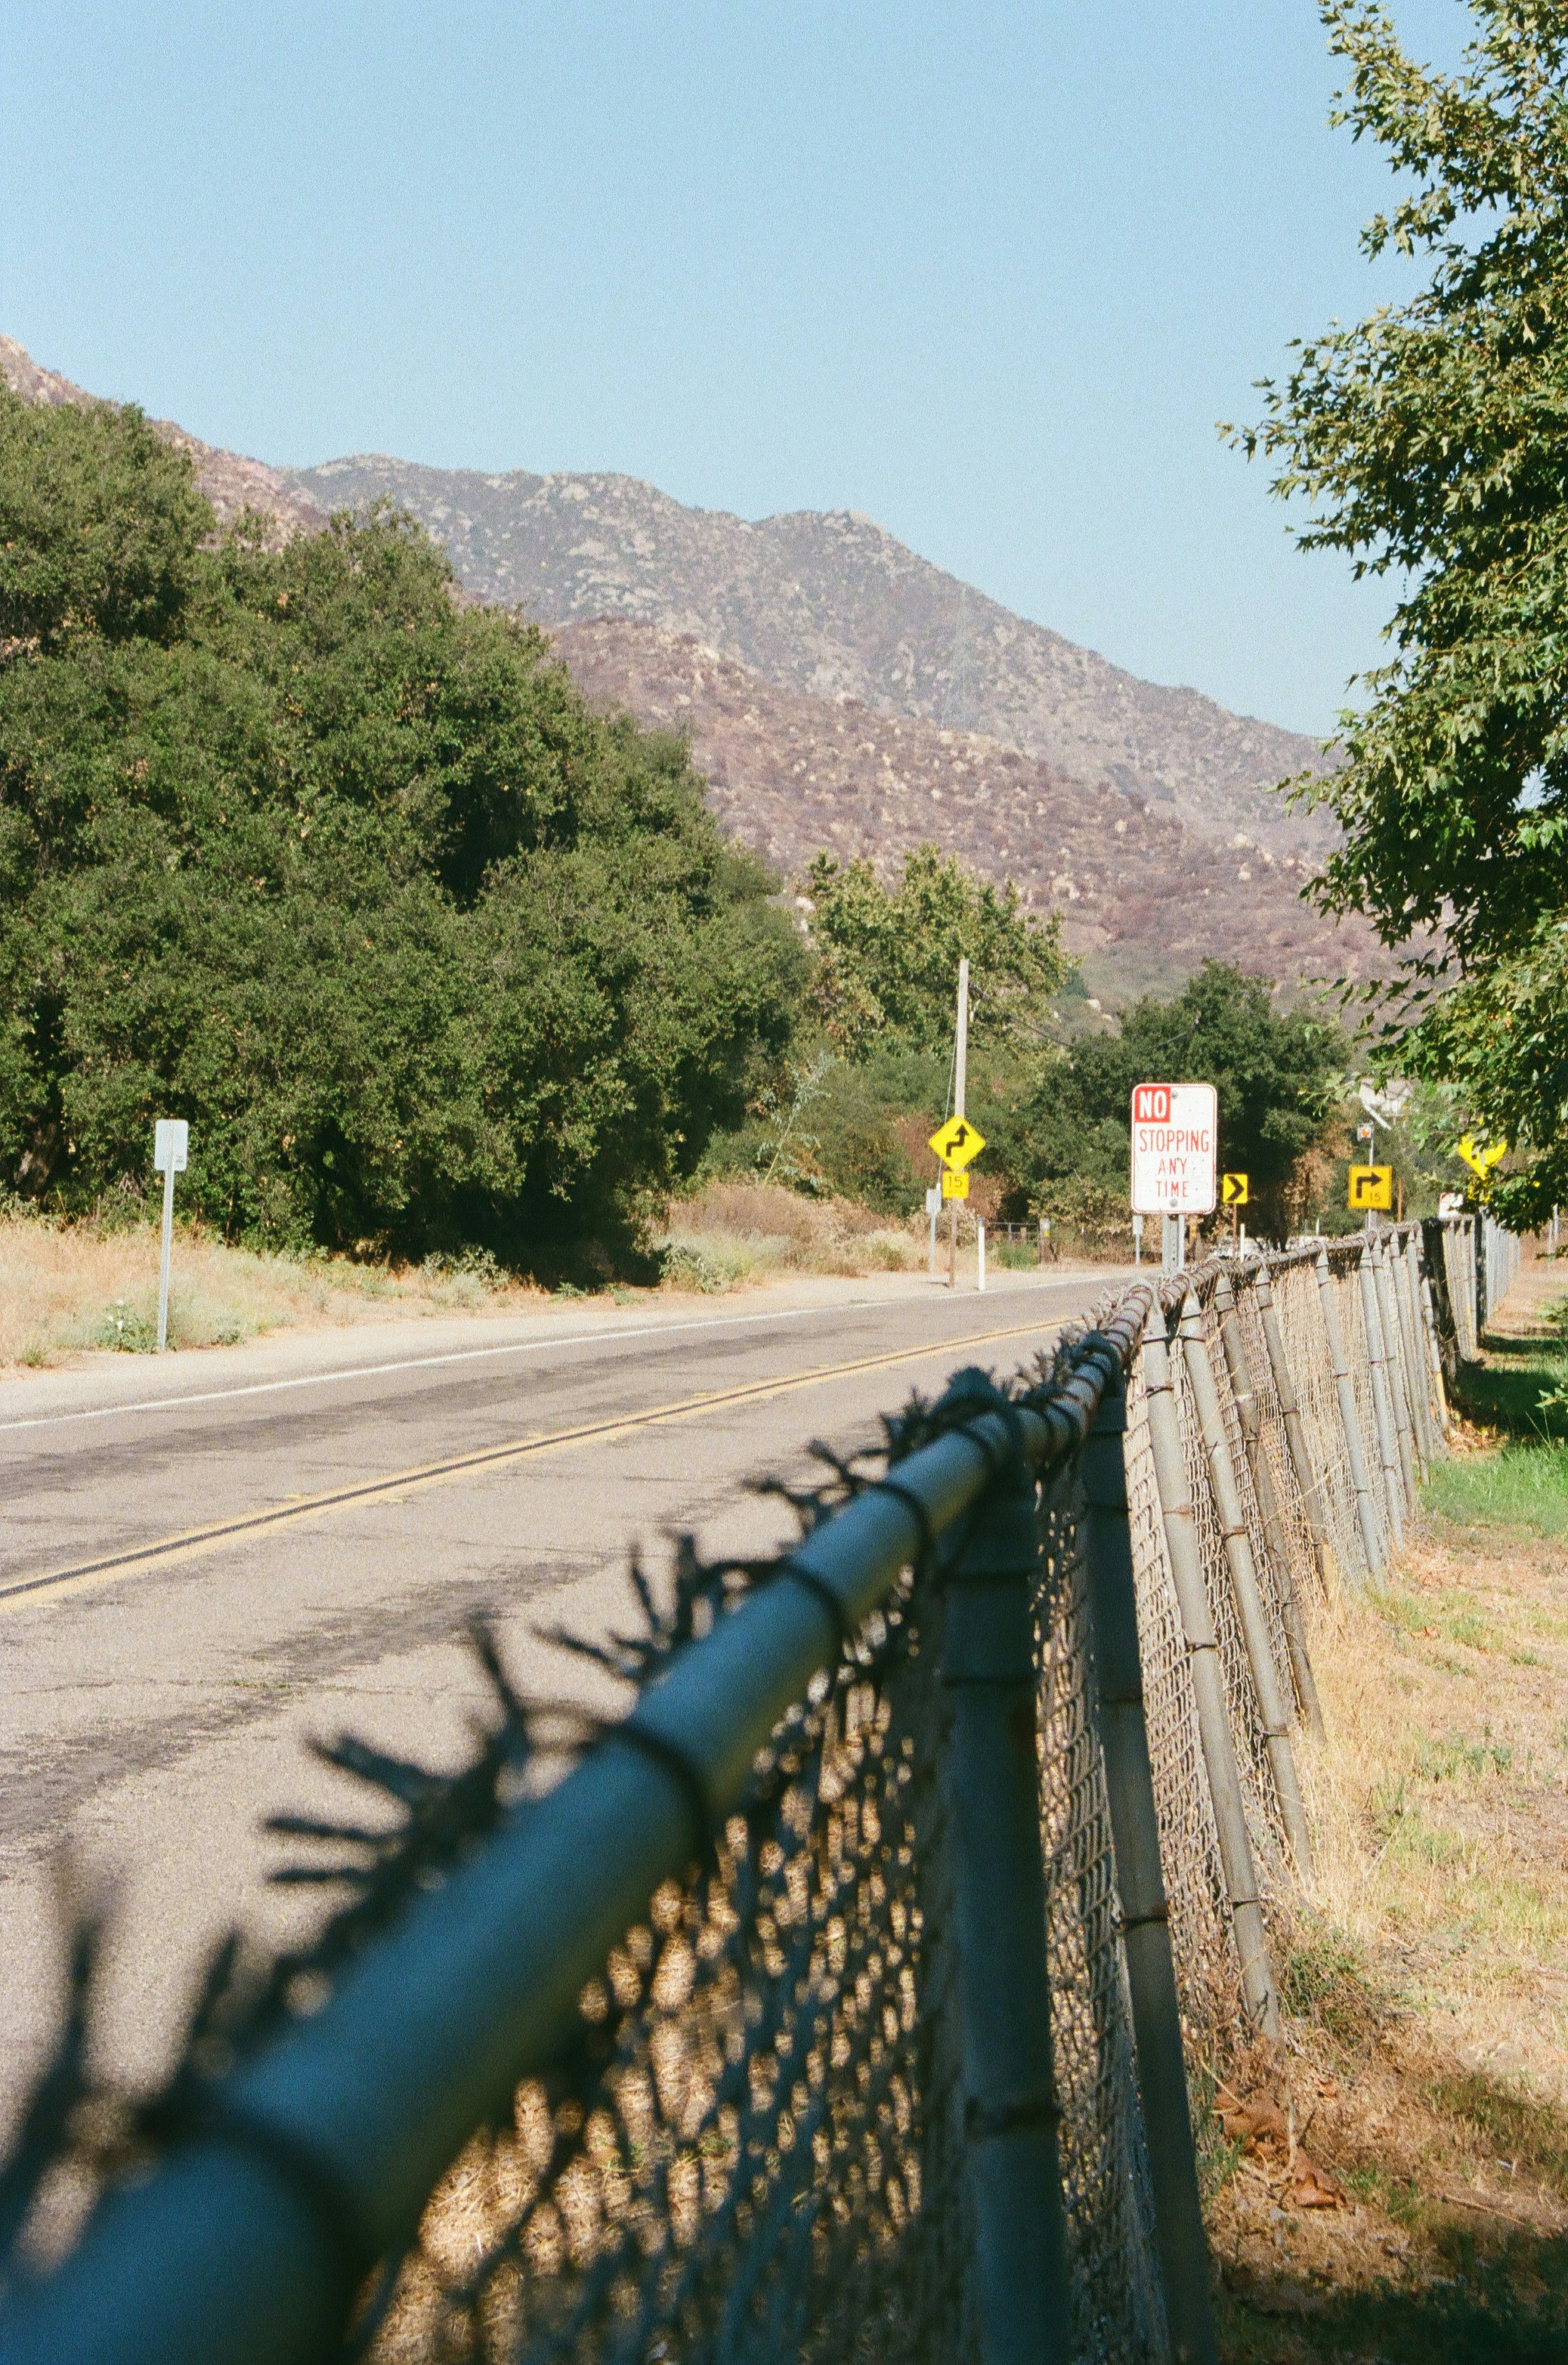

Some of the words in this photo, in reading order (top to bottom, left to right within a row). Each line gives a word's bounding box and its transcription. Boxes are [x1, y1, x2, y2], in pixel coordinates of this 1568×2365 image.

[1140, 1090, 1167, 1118] NO
[1140, 1129, 1209, 1152] STOPPING
[1158, 1158, 1187, 1175] ANY
[948, 1176, 963, 1188] 15
[1156, 1180, 1189, 1198] TIME
[1369, 1192, 1381, 1203] 15
